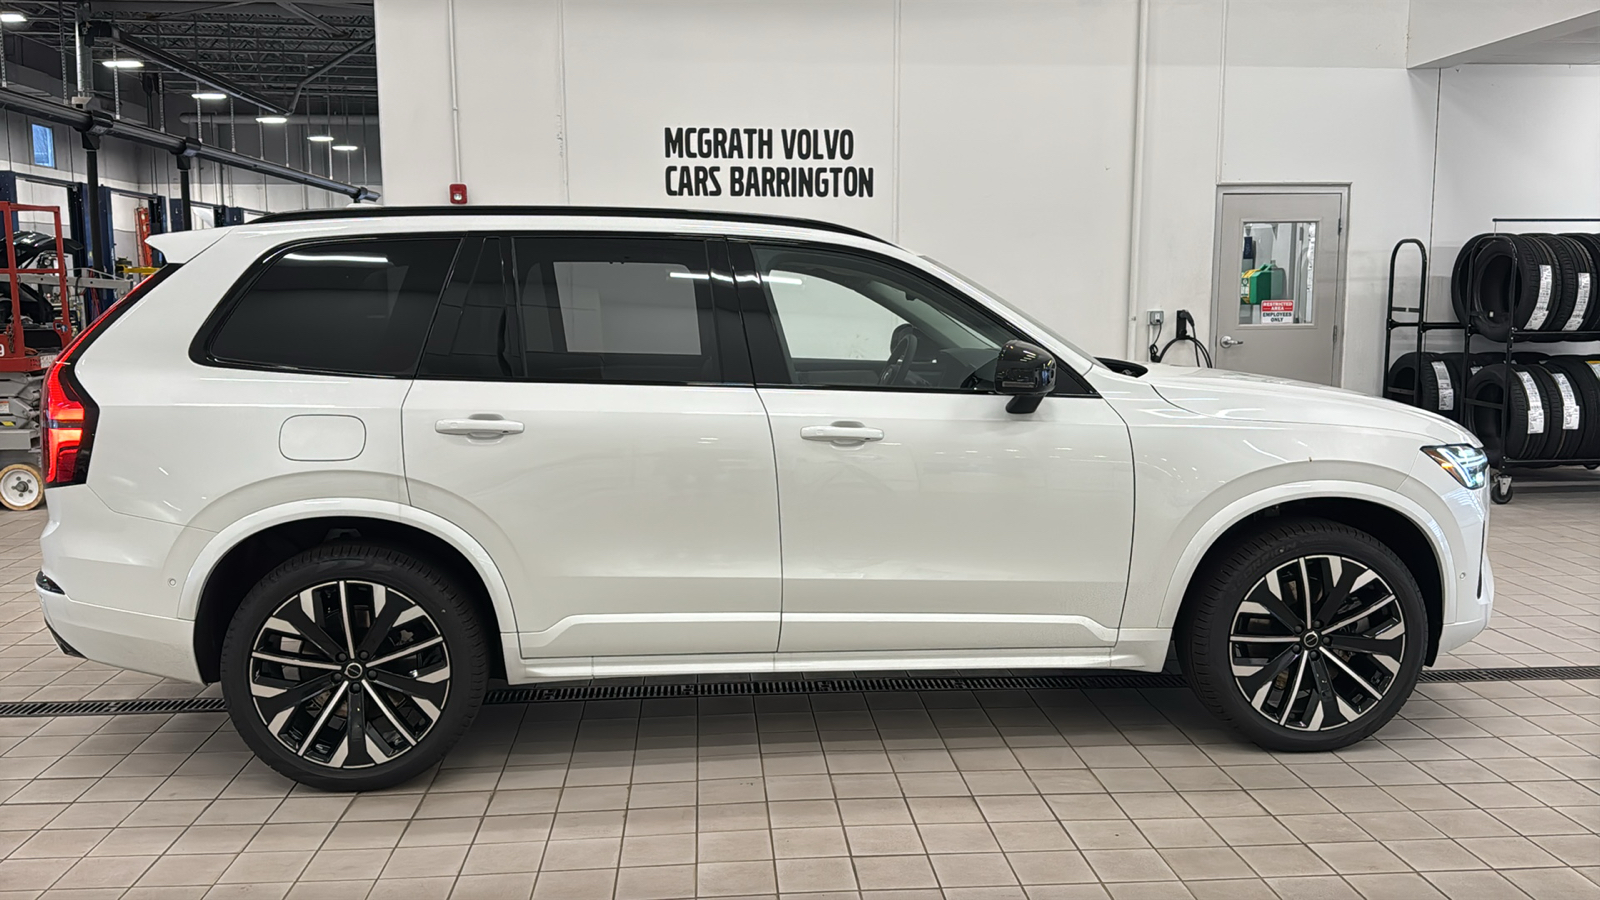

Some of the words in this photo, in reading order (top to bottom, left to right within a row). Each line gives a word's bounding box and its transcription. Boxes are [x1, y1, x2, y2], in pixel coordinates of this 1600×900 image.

[664, 127, 773, 159] MCGRATH
[781, 128, 854, 160] VOLVO
[665, 165, 722, 196] CARS
[730, 166, 874, 198] BARRINGTON
